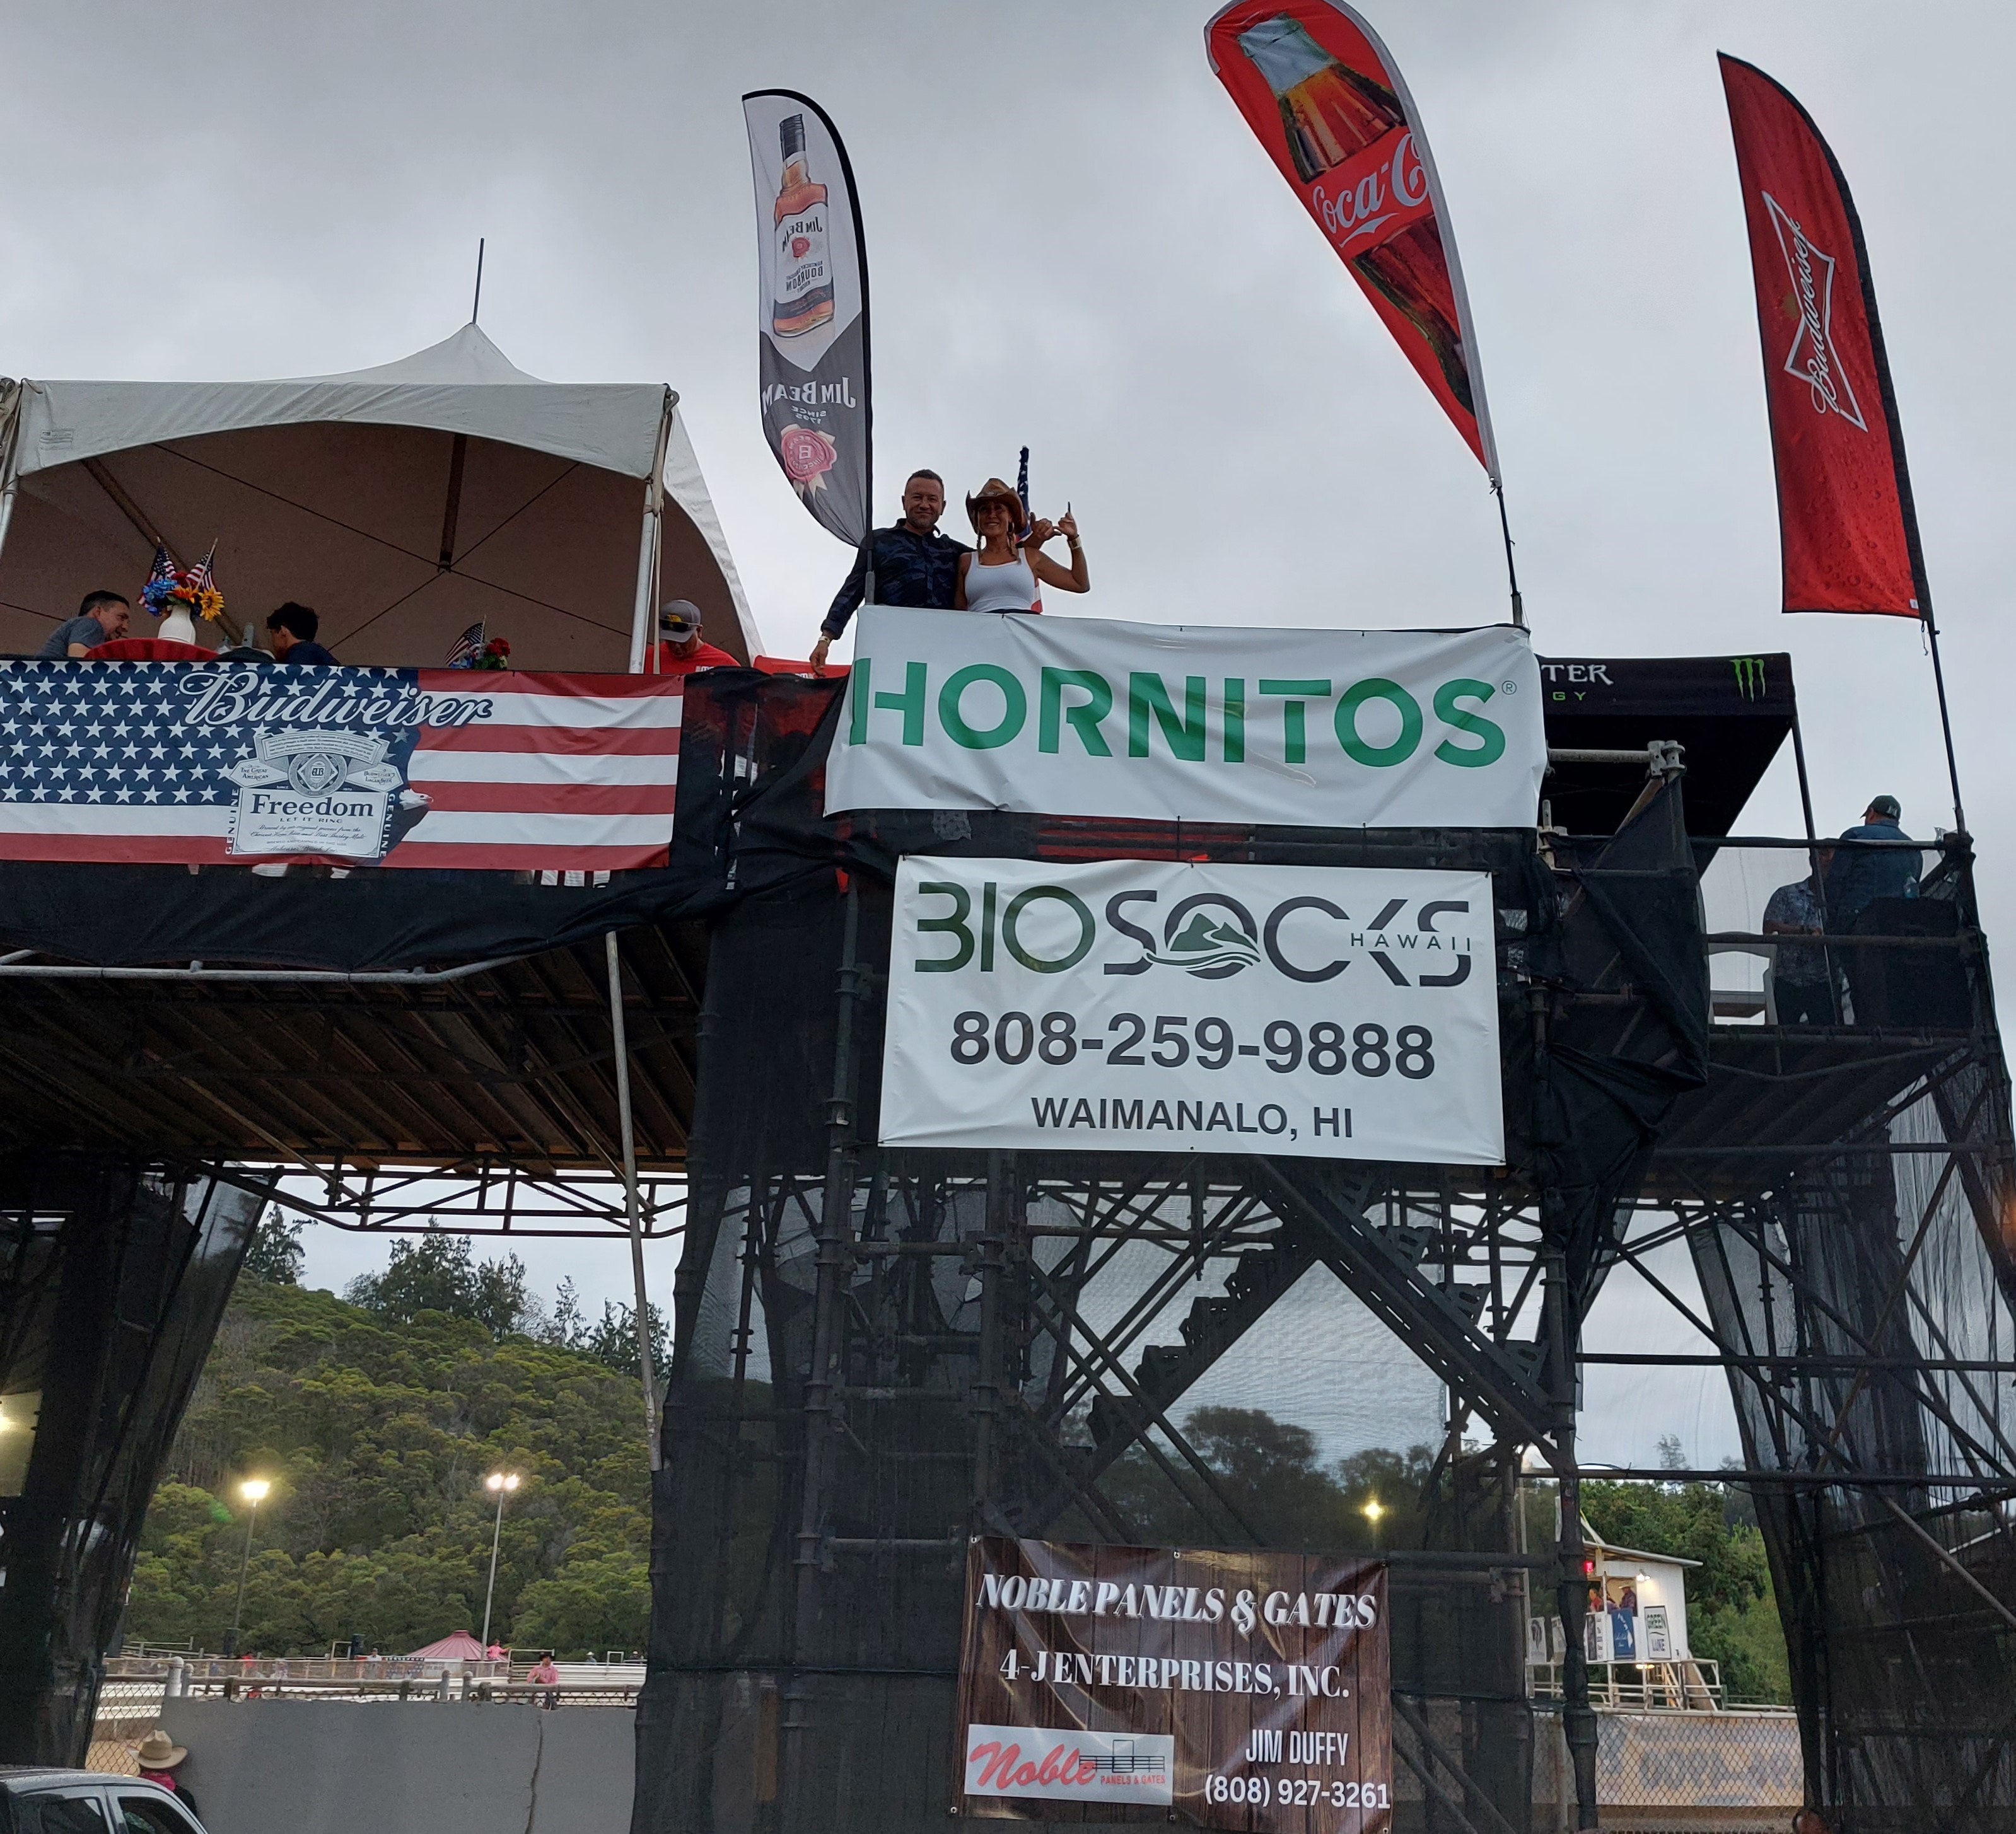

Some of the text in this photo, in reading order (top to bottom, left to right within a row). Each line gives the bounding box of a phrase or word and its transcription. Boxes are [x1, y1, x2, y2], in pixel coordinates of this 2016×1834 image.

[1790, 217, 1839, 414] Budweiser
[179, 671, 492, 727] Budweiser
[224, 788, 239, 855] GENUINE
[250, 793, 373, 817] Freedom
[379, 792, 396, 858] GENUINE
[1350, 932, 1472, 952] HAWAII
[950, 1011, 1435, 1080] 808-259-9888
[1031, 1097, 1353, 1142] WAIMANALO, HI
[975, 1573, 1378, 1637] NOBLE PANELS & GATES
[1052, 1651, 1281, 1702] ENTERPRISES,
[1286, 1664, 1350, 1698] INC.
[969, 1740, 1098, 1790] Noble
[1245, 1729, 1349, 1767] JIM DUFFY
[1100, 1775, 1131, 1785] PANELS
[1141, 1775, 1166, 1784] GATES
[1204, 1774, 1391, 1810] (808) 927-3261
